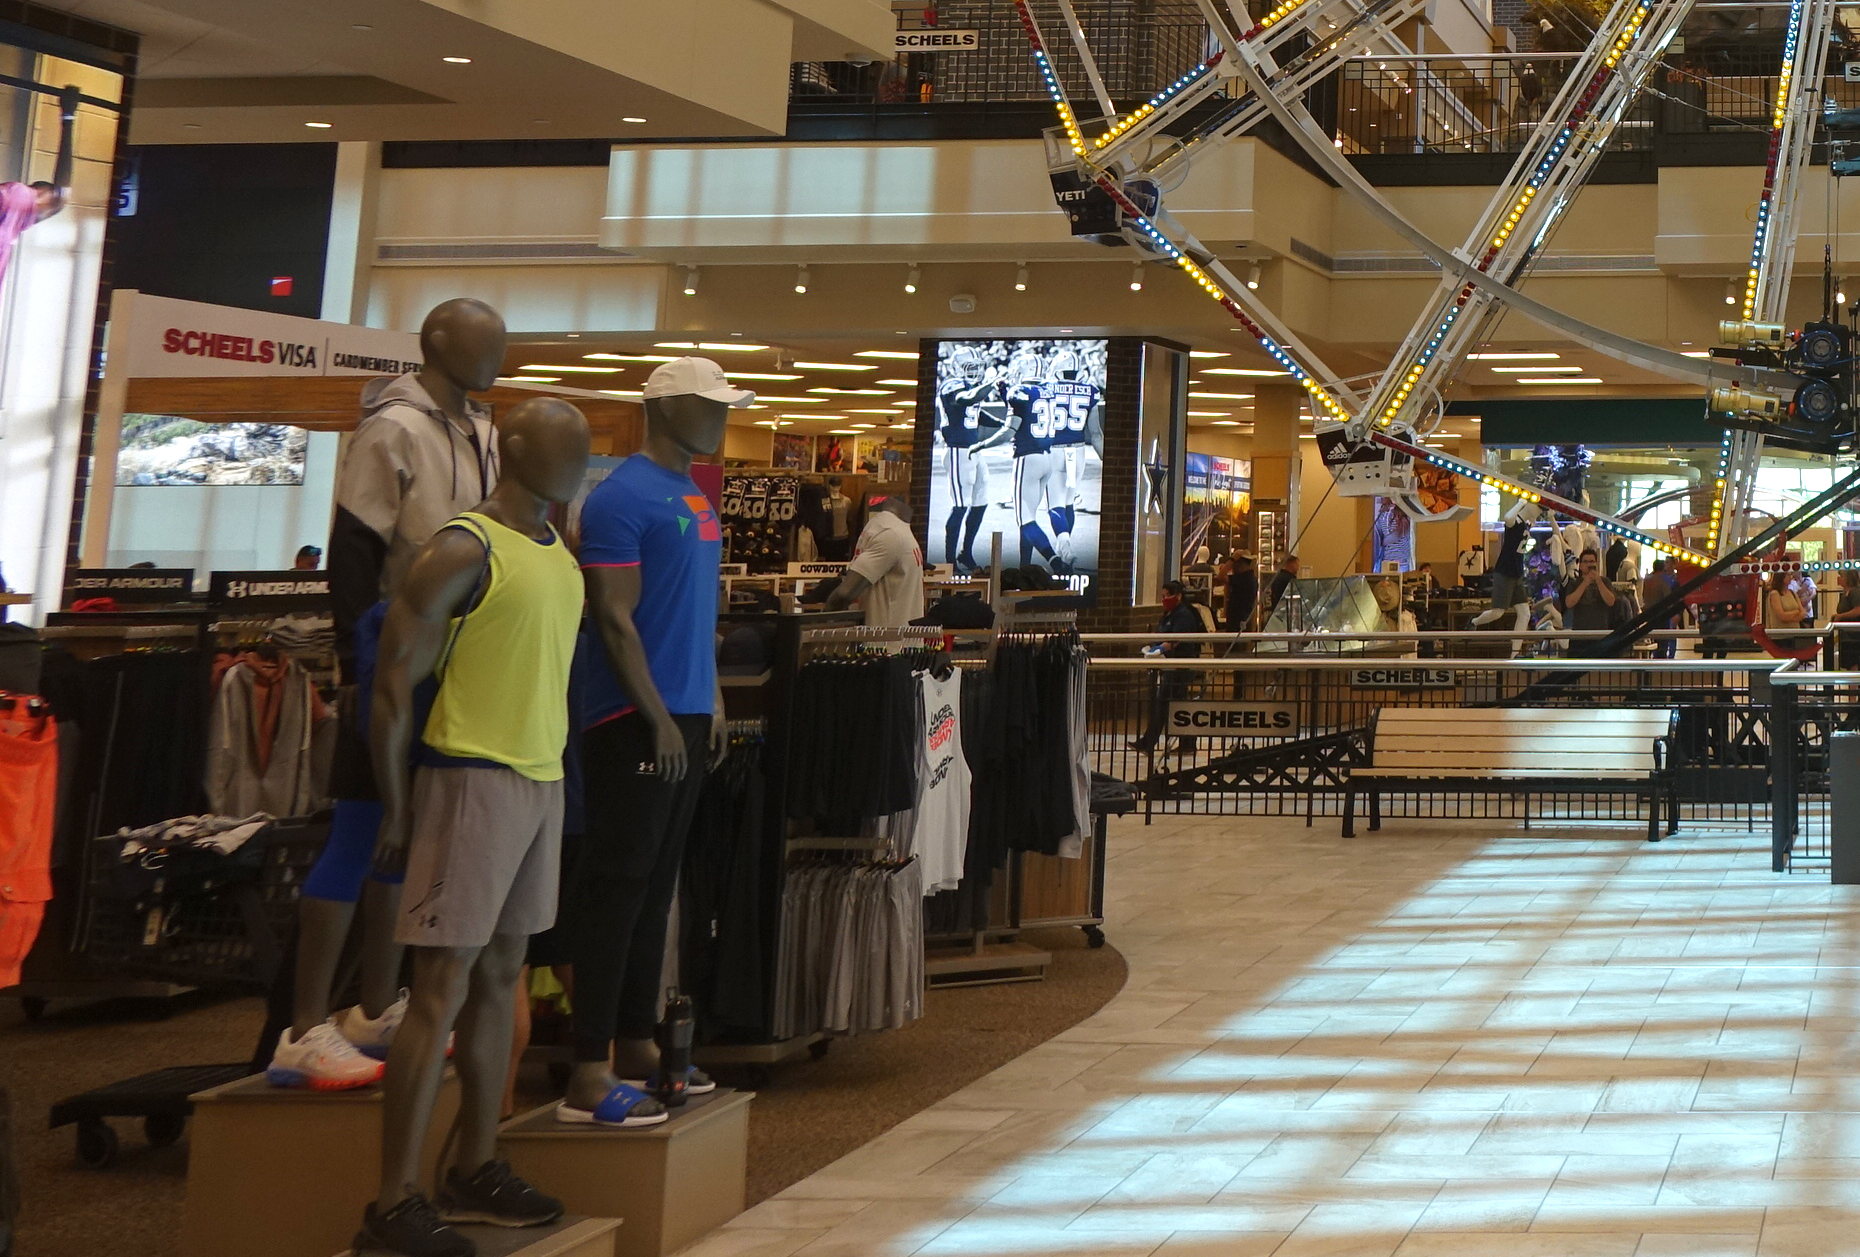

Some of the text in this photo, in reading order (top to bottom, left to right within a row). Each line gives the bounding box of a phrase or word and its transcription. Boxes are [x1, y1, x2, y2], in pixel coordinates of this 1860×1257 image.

[895, 34, 975, 46] SCHEELS
[1056, 190, 1086, 202] YETI
[162, 328, 275, 365] SCHEELS
[277, 341, 317, 369] VISA
[333, 352, 400, 373] CARDMEMBER
[1053, 395, 1091, 431] 55
[109, 577, 185, 589] ARMOUR
[248, 581, 295, 596] UNDER
[1356, 669, 1450, 684] SCHEELS
[1173, 710, 1292, 729] SCHEELS
